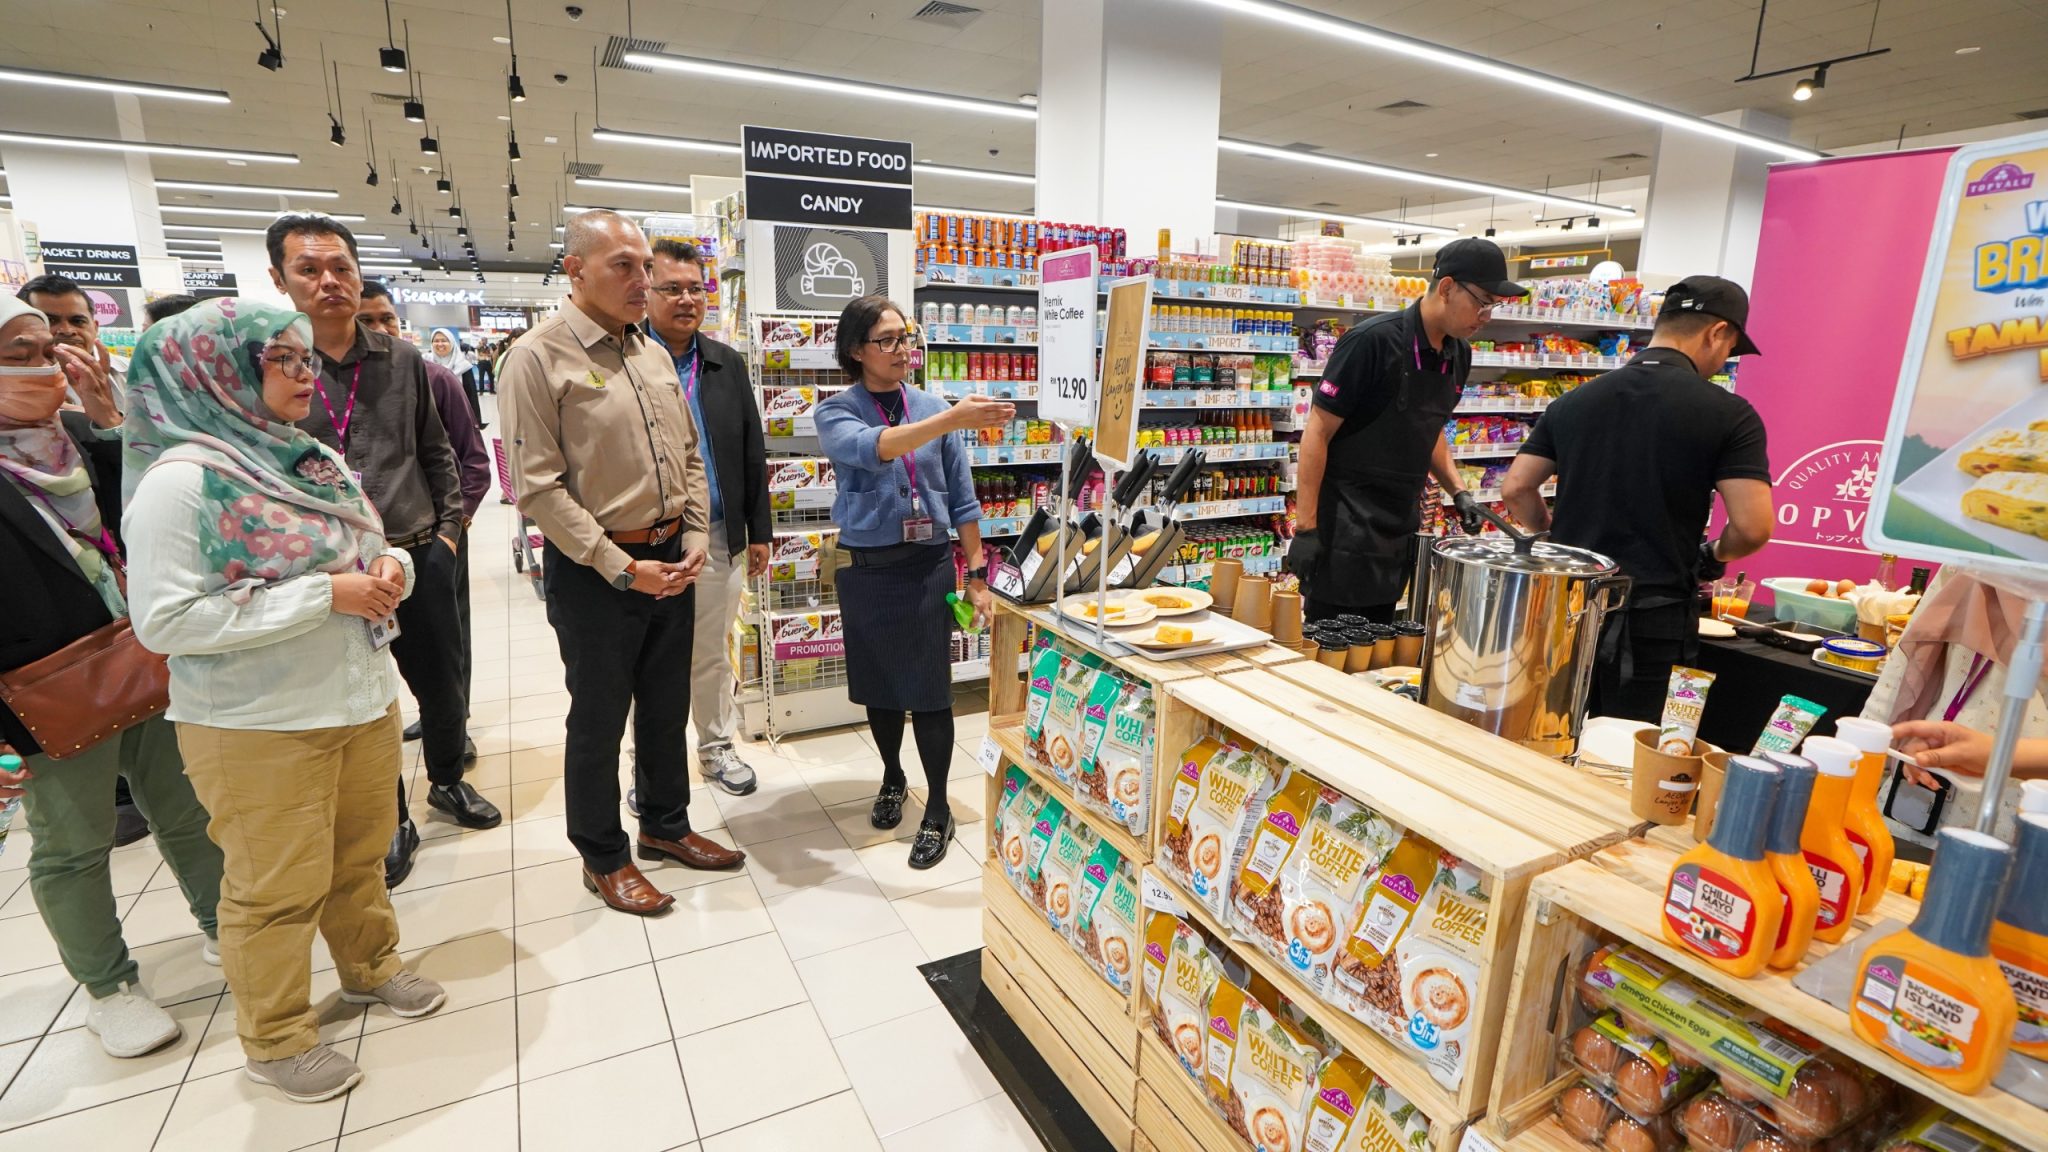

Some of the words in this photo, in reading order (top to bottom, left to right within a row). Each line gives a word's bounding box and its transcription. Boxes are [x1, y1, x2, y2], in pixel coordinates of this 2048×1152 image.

[751, 140, 853, 166] IMPORTED
[857, 151, 906, 171] FOOD
[1970, 176, 2031, 194] TOPVALU
[800, 193, 863, 214] CANDY
[87, 249, 130, 260] DRINKS
[94, 271, 123, 282] MILK
[1020, 273, 1039, 286] IMP
[1044, 295, 1063, 308] Premix
[1044, 309, 1058, 321] White
[1059, 308, 1084, 320] Coffee
[771, 332, 802, 343] bueno
[824, 333, 838, 343] bu
[1208, 338, 1241, 348] IMPORT
[909, 356, 920, 365] ON
[1114, 355, 1132, 374] AEON
[1056, 376, 1087, 401] 12.90
[1204, 394, 1238, 404] IMPRT
[773, 399, 803, 410] bueno
[777, 472, 805, 484] bueno
[1789, 451, 1852, 490] QUALITY
[1778, 503, 1866, 532] OPV
[781, 544, 810, 556] bueno
[1003, 575, 1017, 592] 29
[781, 625, 809, 638] bueno
[790, 642, 845, 655] PROMOTION
[1055, 684, 1078, 709] WHITE
[1667, 701, 1701, 716] WHITE
[1115, 712, 1144, 735] WHI
[1115, 729, 1142, 745] COFF
[1209, 769, 1247, 805] WHITE
[1311, 826, 1365, 874] WHITE
[1309, 848, 1352, 883] COFFEE
[1808, 865, 1827, 881] LLI
[1114, 877, 1137, 909] WHIT
[1384, 878, 1417, 901] TOPVALU
[1702, 883, 1735, 907] CHILLI
[1112, 896, 1136, 924] COFFEE
[1700, 893, 1733, 915] MAYO
[1431, 917, 1484, 947] COFFEE
[1177, 957, 1199, 981] WH
[1999, 965, 2048, 990] OUSAND
[1906, 979, 1964, 1014] THOUSAND
[2011, 980, 2048, 1000] AND
[1620, 981, 1651, 1003] Omega
[1651, 998, 1687, 1024] Chicken
[1687, 1017, 1711, 1038] Eggs
[1904, 988, 1962, 1025] ISLAND
[1248, 1030, 1303, 1082] WHITE
[1251, 1052, 1294, 1091] COFFEE
[1321, 1091, 1355, 1117] TOPVALU
[1361, 1135, 1382, 1152] CO
